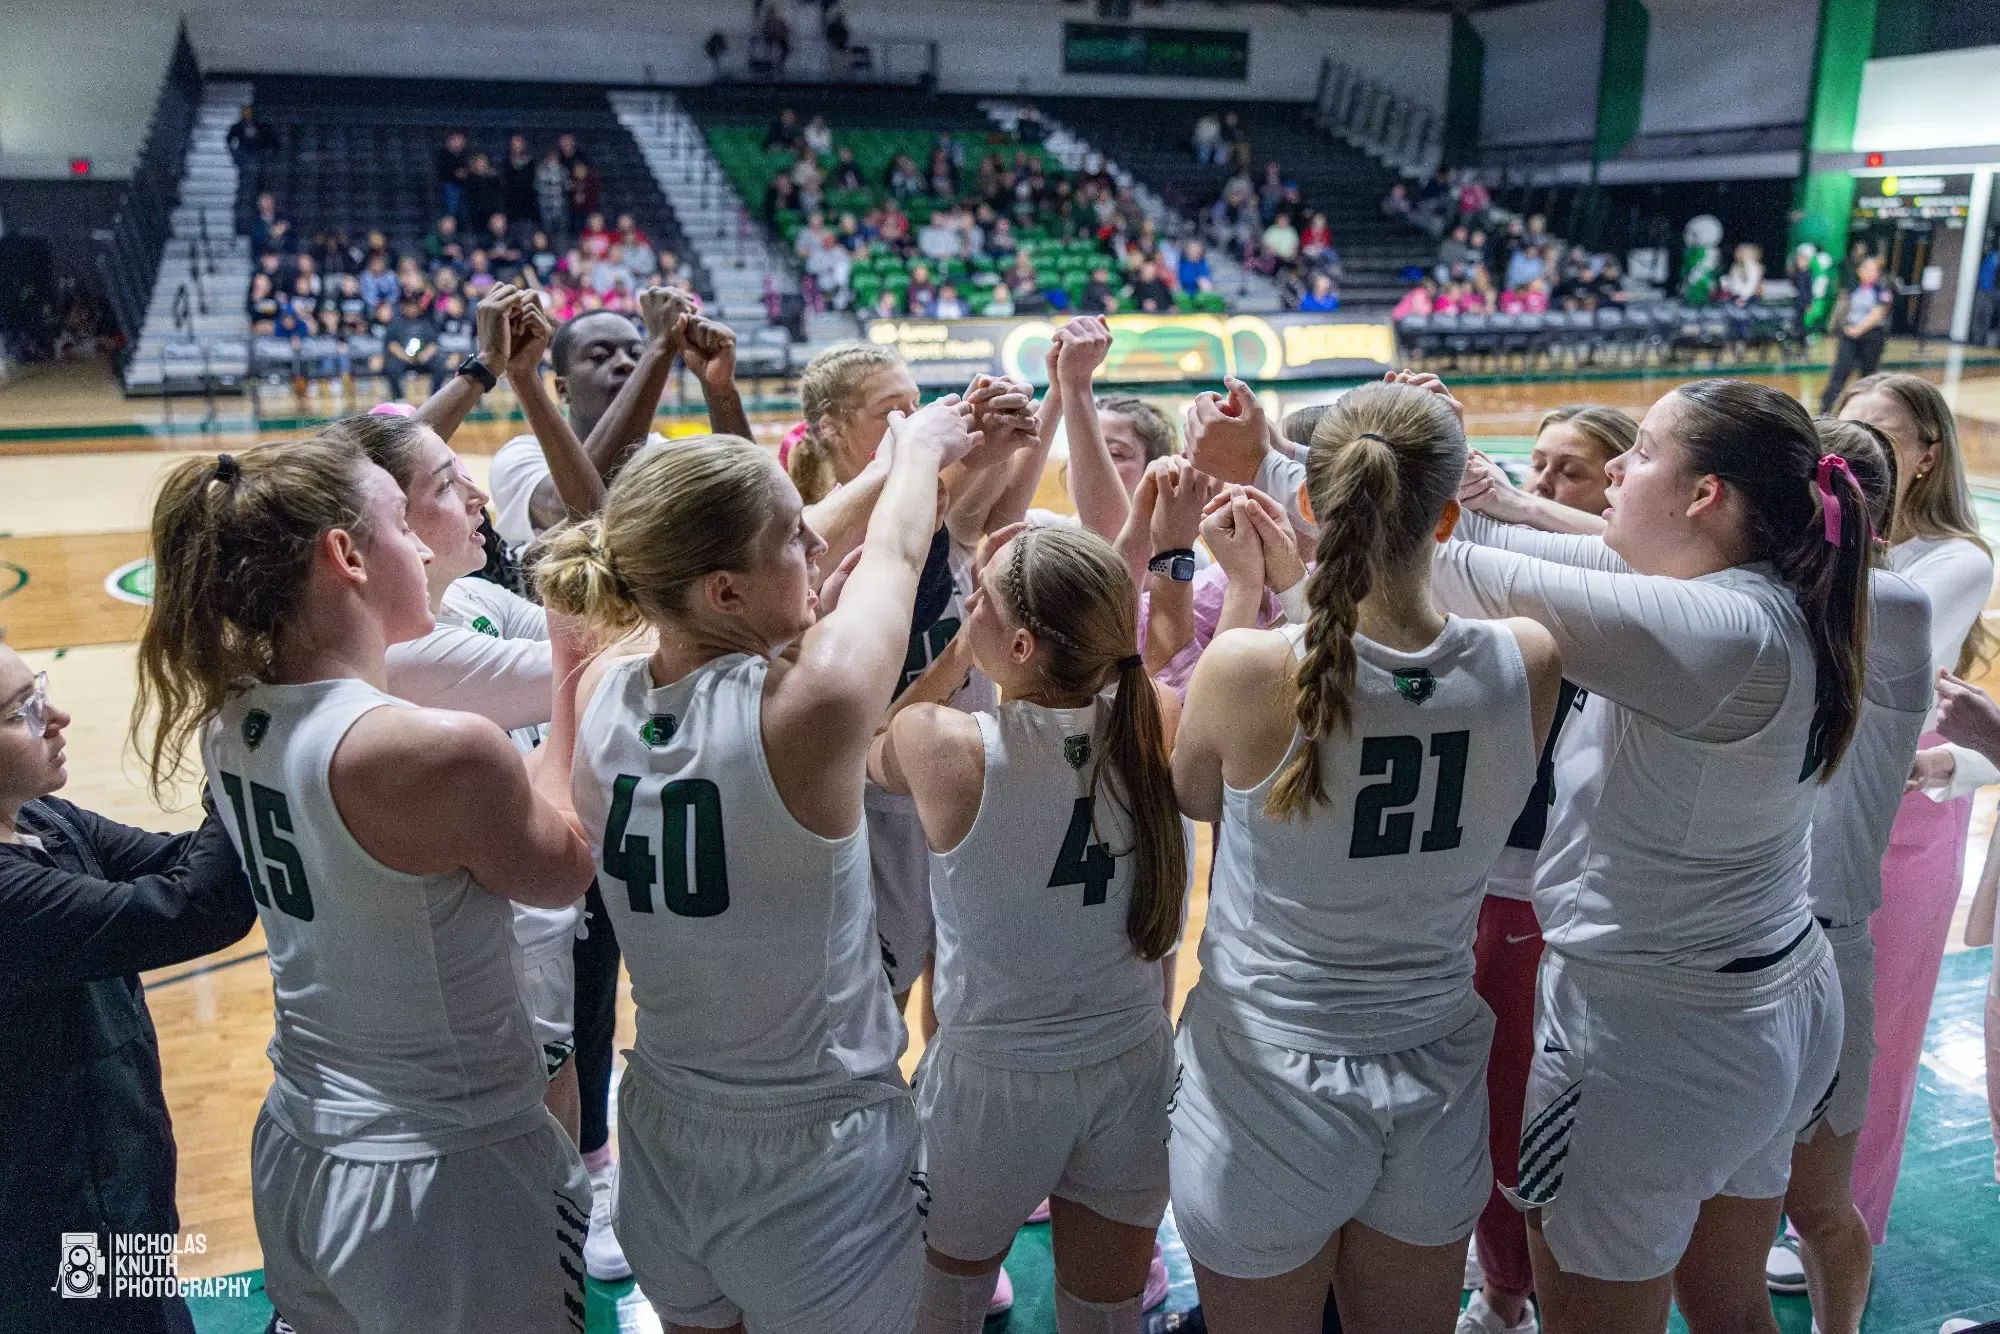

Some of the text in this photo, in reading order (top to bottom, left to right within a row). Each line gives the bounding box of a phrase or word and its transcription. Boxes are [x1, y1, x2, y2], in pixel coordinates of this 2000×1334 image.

[220, 770, 315, 922] 15
[603, 773, 730, 917] 40
[1046, 796, 1116, 906] 4
[1348, 730, 1470, 859] 21
